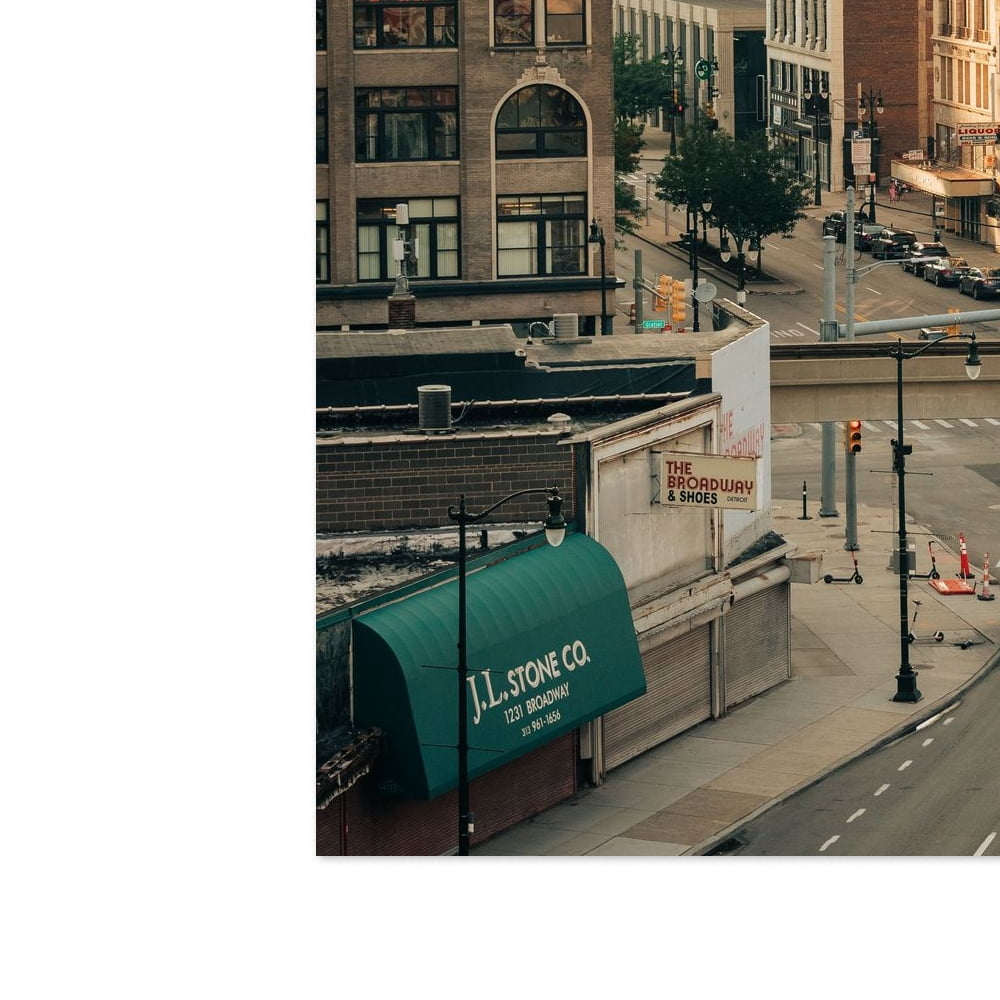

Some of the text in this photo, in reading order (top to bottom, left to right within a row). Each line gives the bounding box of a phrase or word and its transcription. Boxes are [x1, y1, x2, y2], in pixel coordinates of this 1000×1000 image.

[666, 461, 692, 475] THE
[667, 476, 753, 495] BROADWAY
[667, 490, 676, 502] &
[680, 491, 717, 505] SHOES
[562, 640, 591, 672] CO.
[504, 682, 570, 724] 1231 BROADWAY
[521, 709, 561, 737] 313 961-1656
